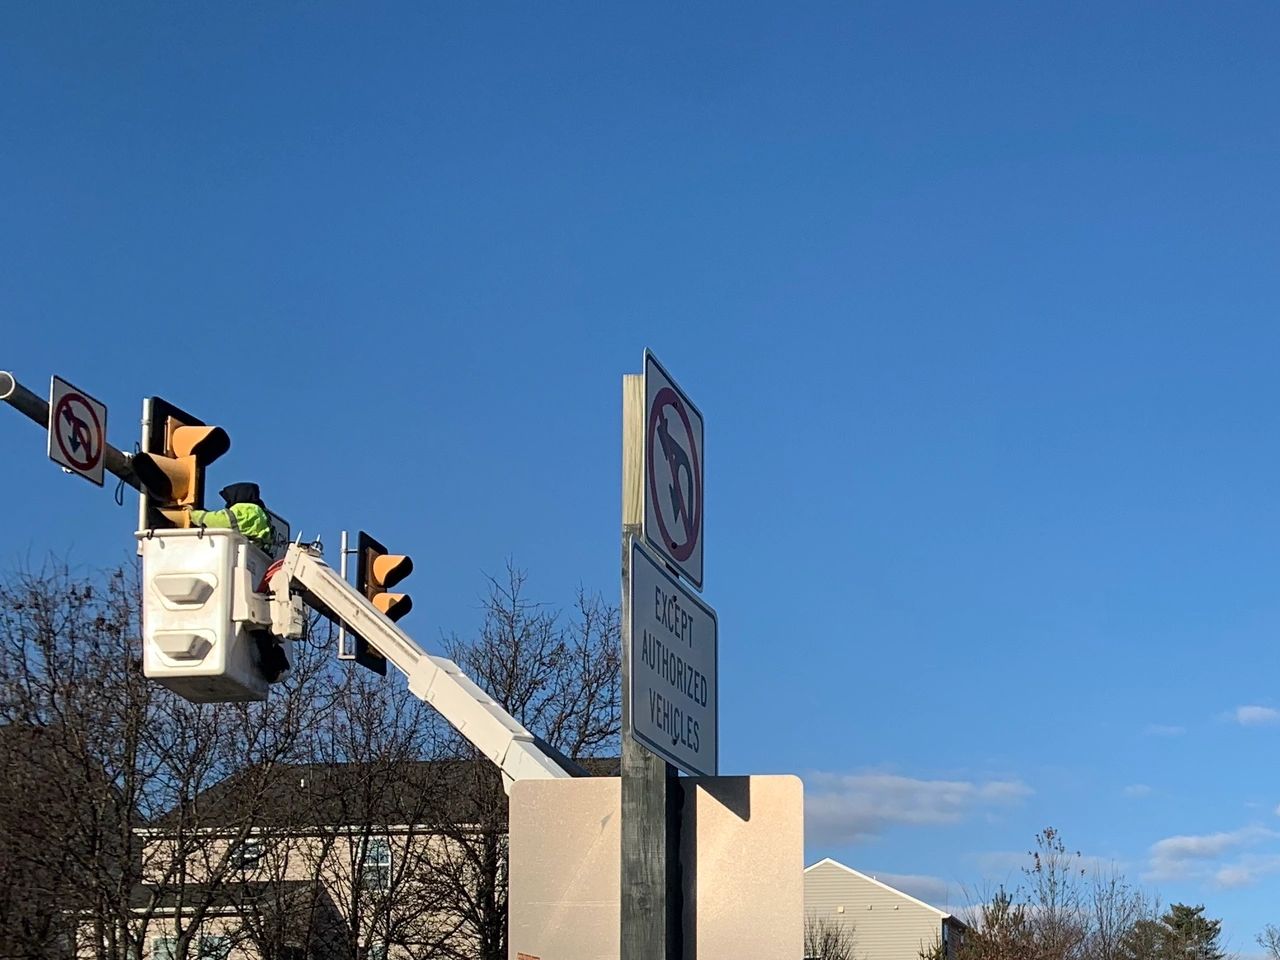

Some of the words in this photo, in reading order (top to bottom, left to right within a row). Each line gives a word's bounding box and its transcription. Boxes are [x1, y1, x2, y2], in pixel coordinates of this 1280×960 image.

[655, 585, 694, 648] EXCEPT
[641, 629, 708, 708] AUTHORIZED
[649, 687, 700, 753] VEHICLES
